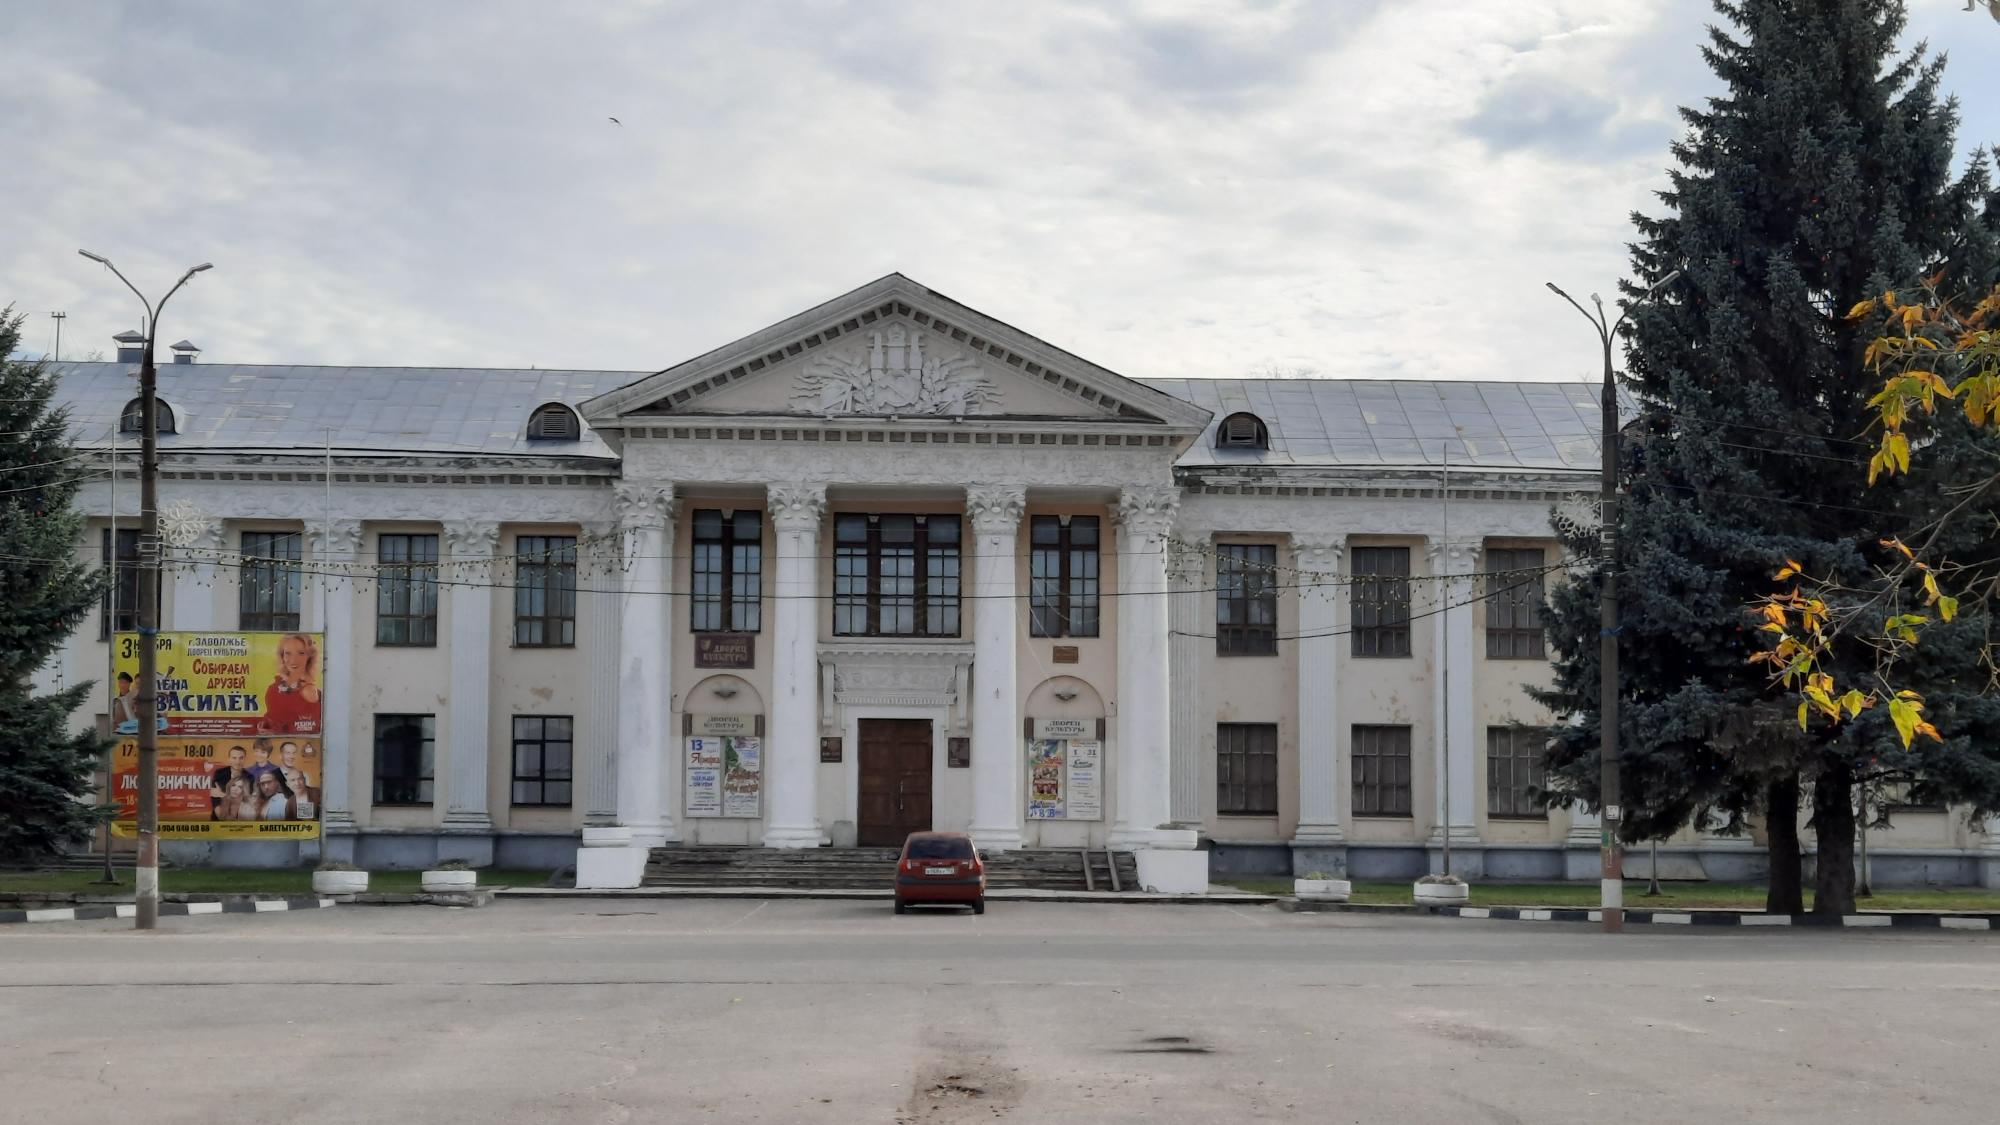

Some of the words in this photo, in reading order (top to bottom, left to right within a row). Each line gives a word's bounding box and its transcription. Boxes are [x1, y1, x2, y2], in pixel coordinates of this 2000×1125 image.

[121, 638, 133, 659] 3
[134, 638, 172, 650] НБРЯ
[188, 637, 246, 647] г.ЗАВОЛЖЬЕ
[187, 648, 212, 656] ДВОРЕЦ
[214, 648, 247, 656] КУЛЬТУРЫ
[206, 676, 246, 689] ДРУЗЕЙ
[156, 691, 259, 711] ВАСИЛЁК
[184, 744, 214, 757] 18:00
[691, 739, 703, 751] 13
[120, 775, 211, 790] ЛЮВНИЧКИ
